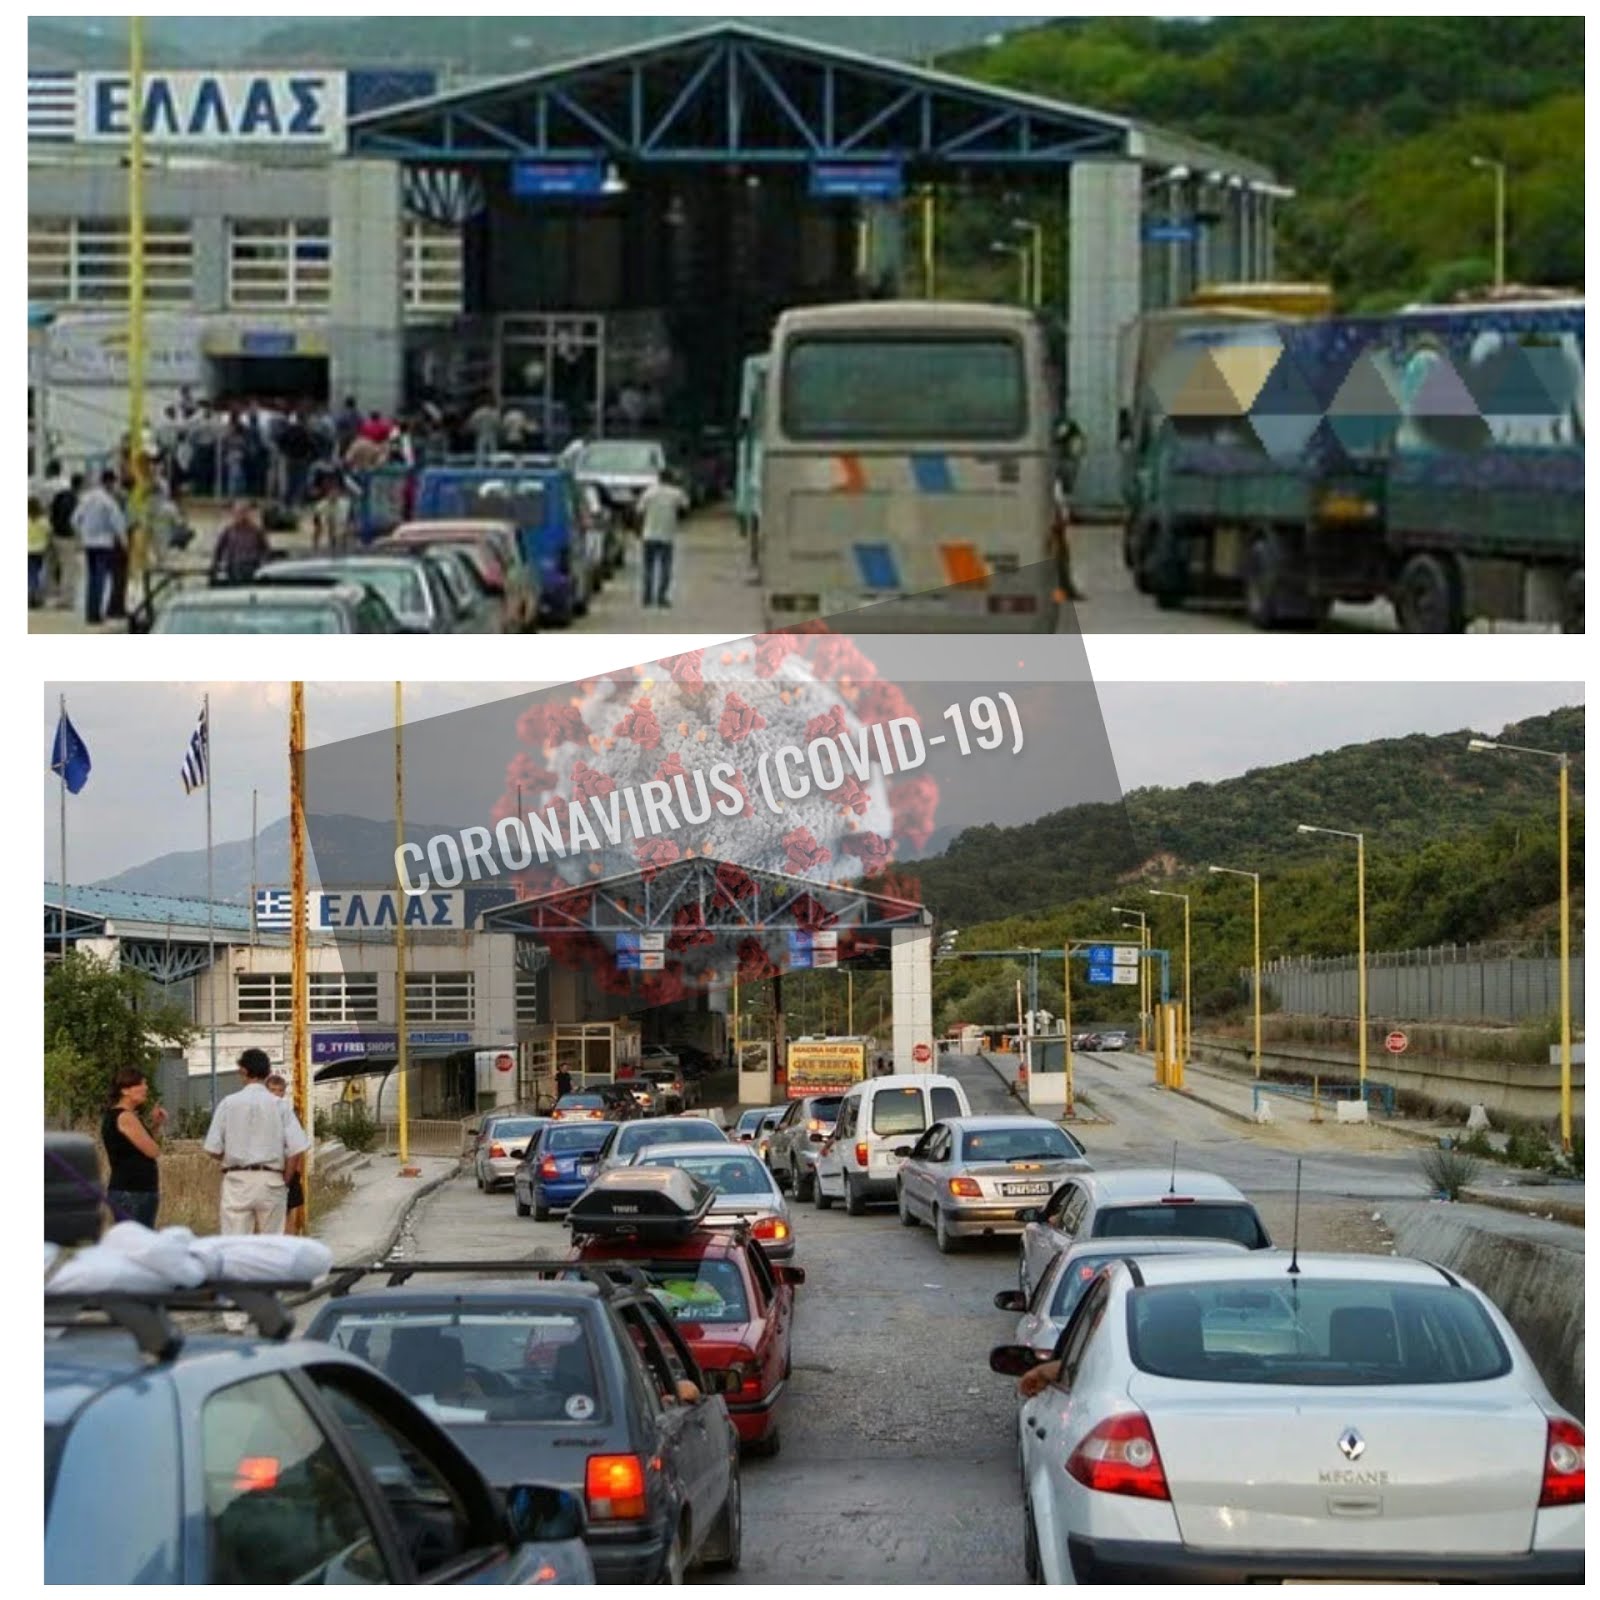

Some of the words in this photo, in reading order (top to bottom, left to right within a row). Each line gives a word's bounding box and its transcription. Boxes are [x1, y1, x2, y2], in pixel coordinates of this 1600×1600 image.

[94, 78, 326, 133] ΕΛΛΑΣ
[319, 894, 453, 926] ΕΛΛΑΣ
[367, 1041, 396, 1052] SHOPS
